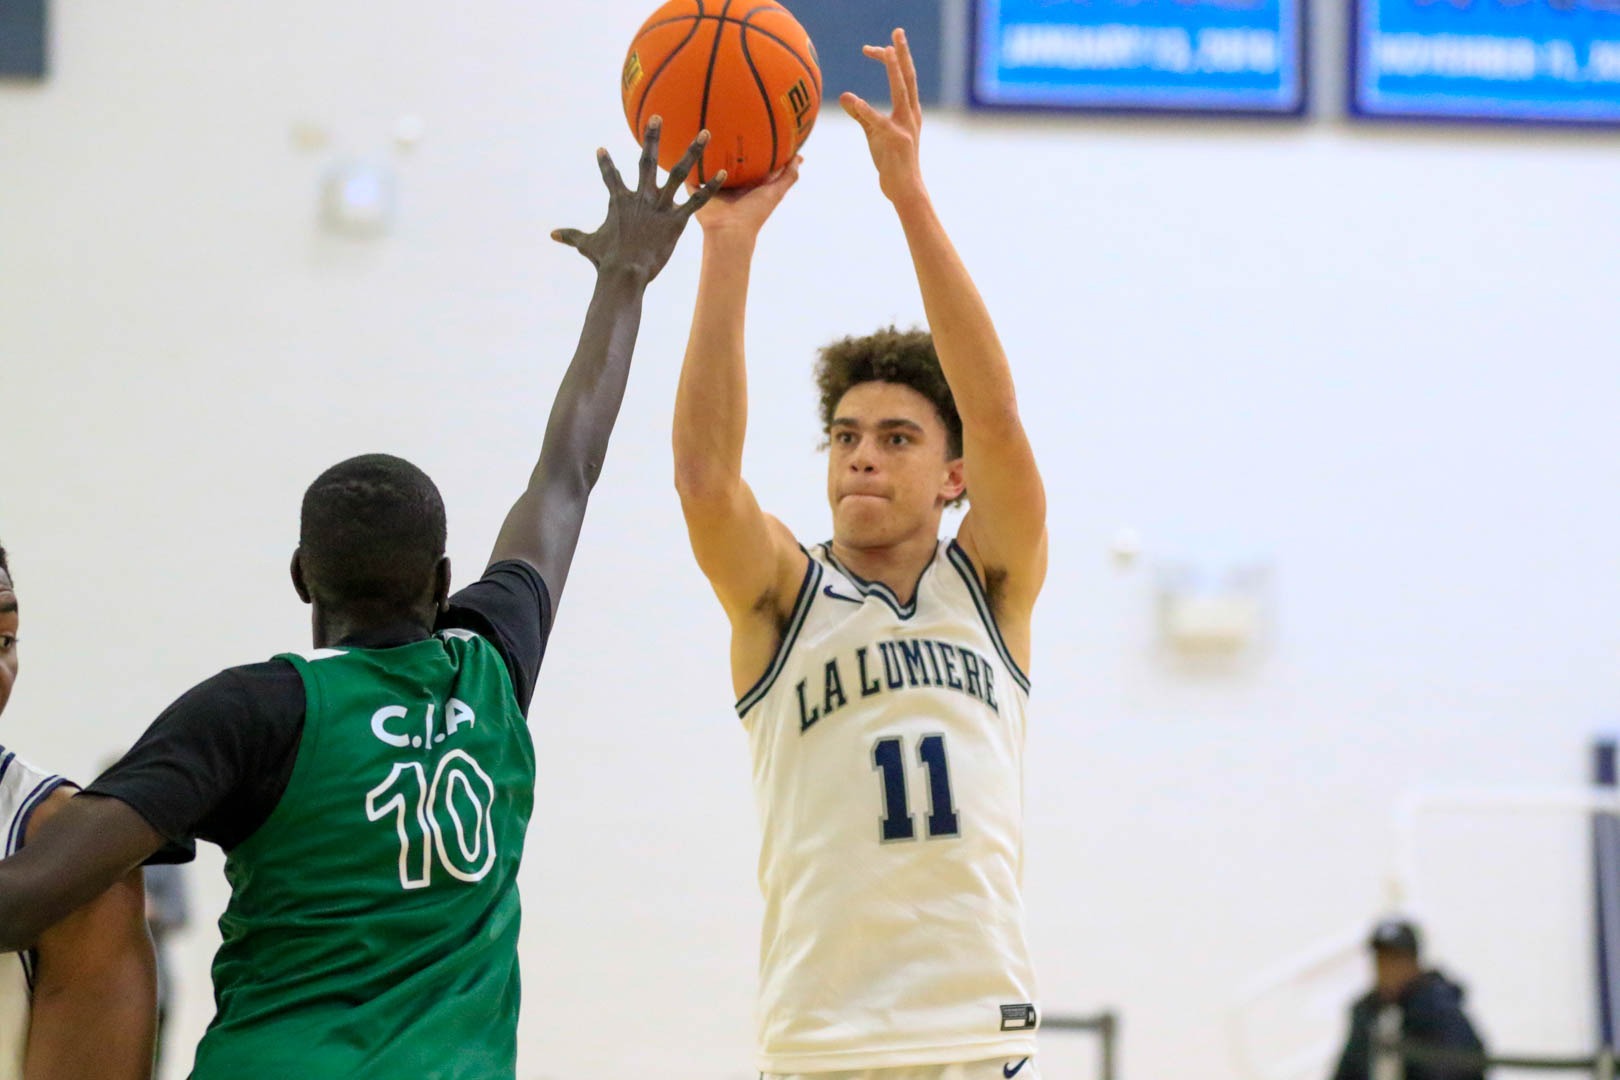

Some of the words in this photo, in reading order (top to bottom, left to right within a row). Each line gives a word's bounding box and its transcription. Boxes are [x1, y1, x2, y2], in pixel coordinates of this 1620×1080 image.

[370, 697, 476, 750] C.I.A
[795, 657, 847, 736] LA
[856, 637, 1000, 718] LUMIERE
[365, 748, 497, 890] 10
[870, 732, 961, 845] 11
